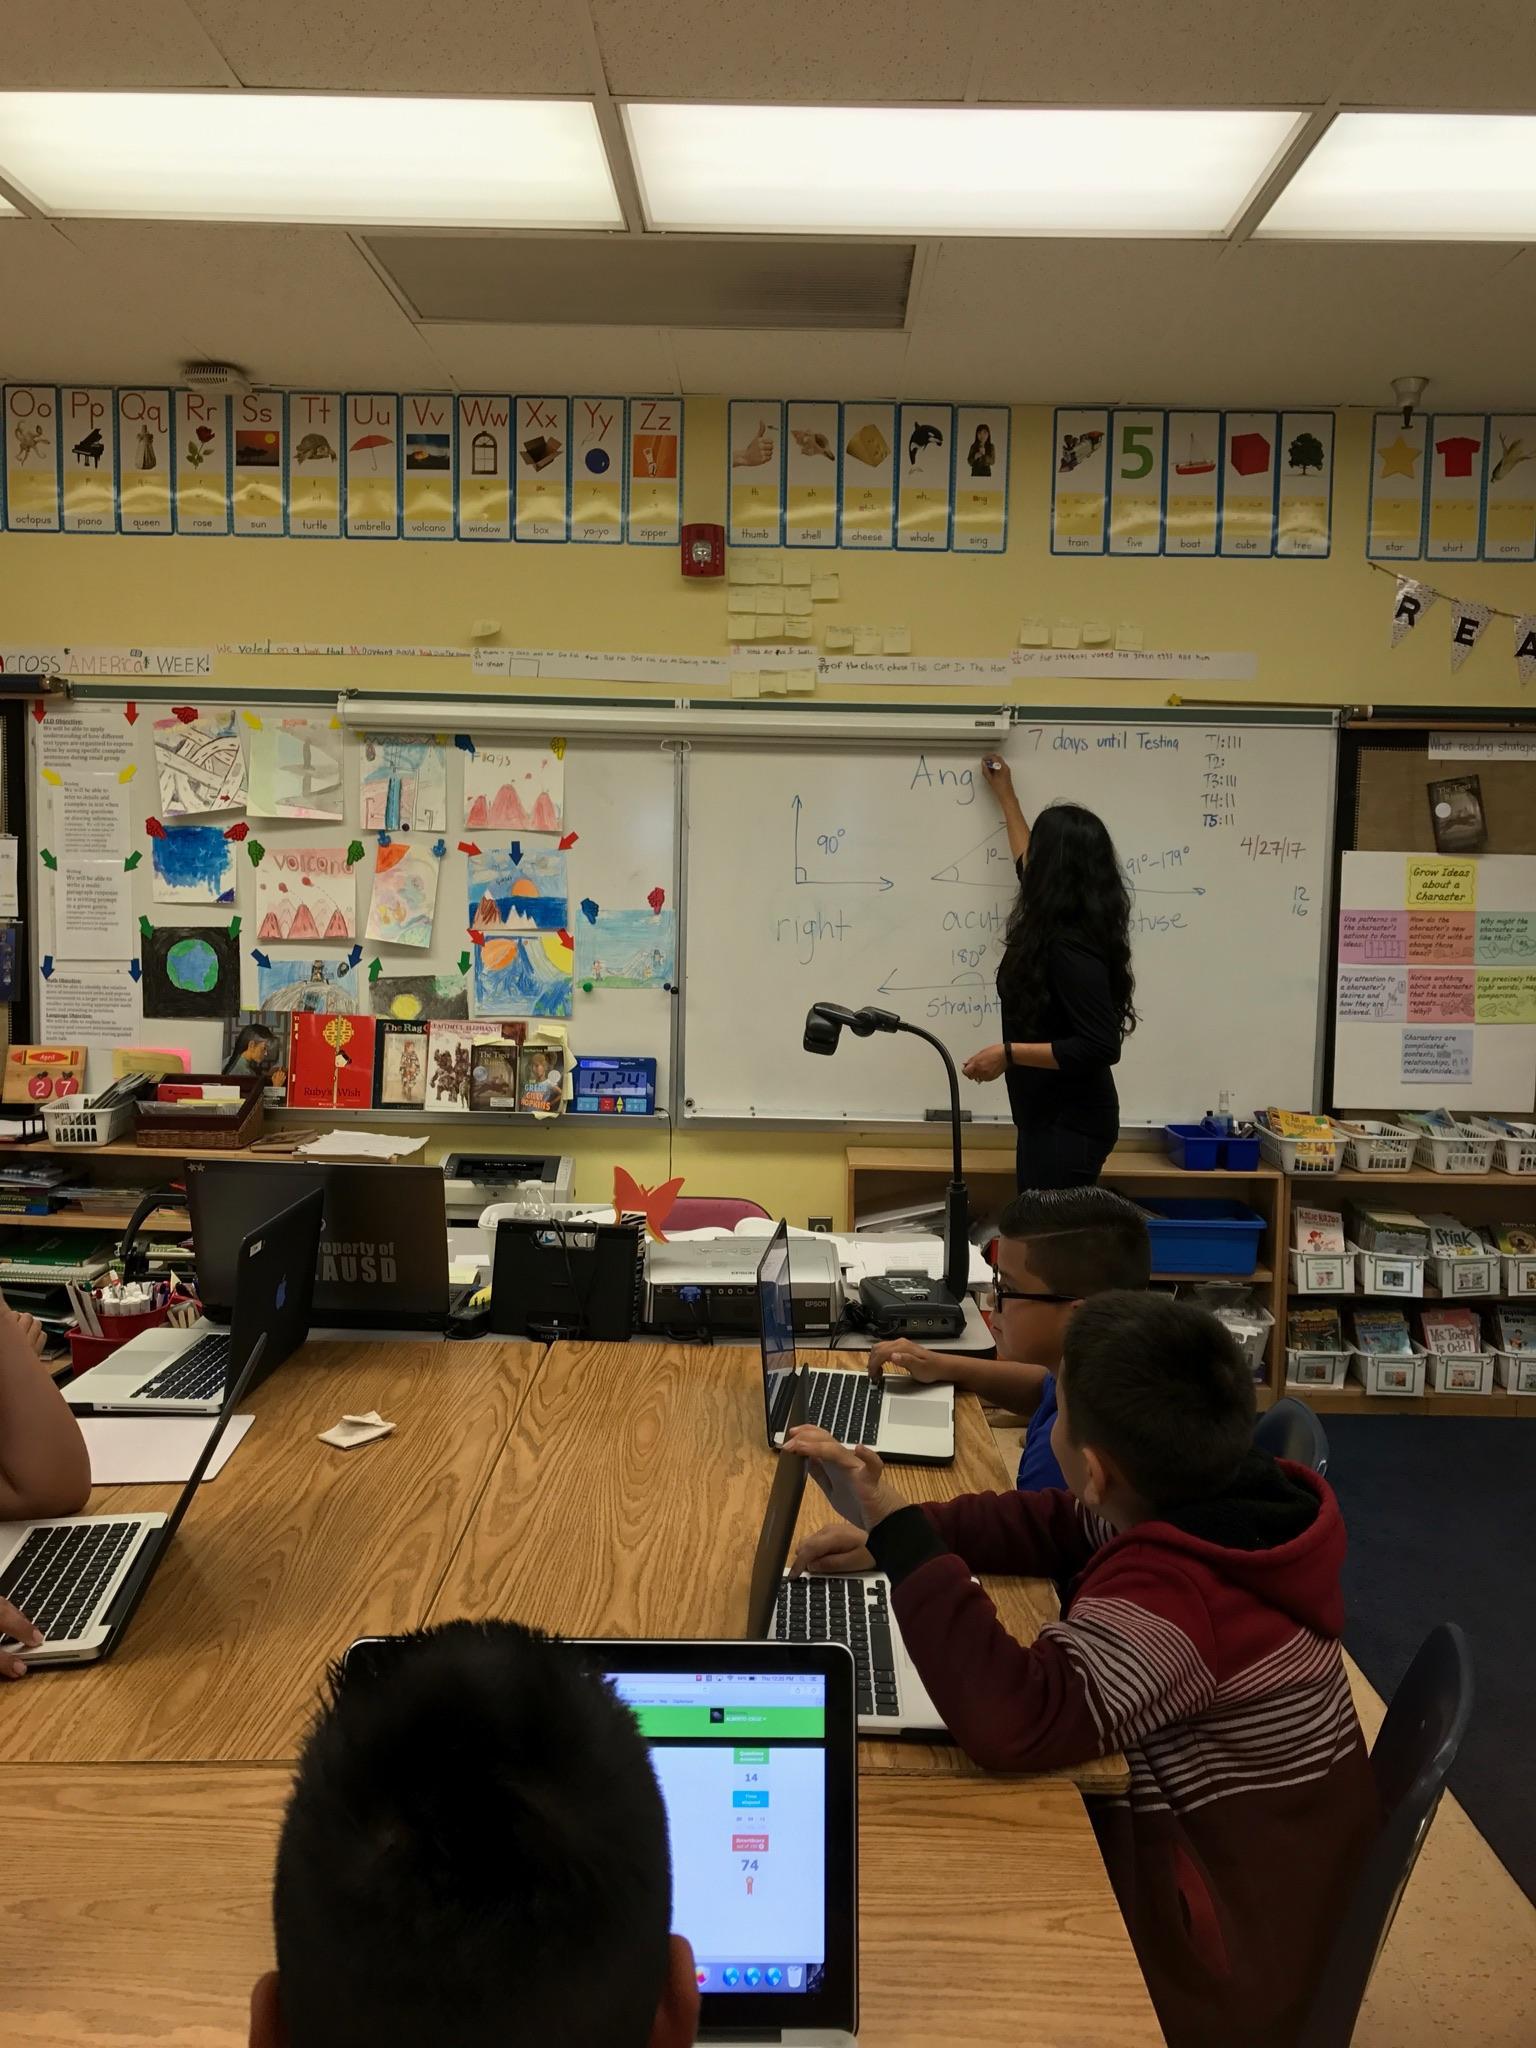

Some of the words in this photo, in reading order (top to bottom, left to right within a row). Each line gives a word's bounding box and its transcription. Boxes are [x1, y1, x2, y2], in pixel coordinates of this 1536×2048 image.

[10, 390, 52, 418] Oo
[187, 393, 217, 422] Rr
[242, 395, 272, 424] Ss
[72, 391, 105, 429] Pp
[121, 393, 167, 433] Qq
[300, 397, 331, 424] Tt
[353, 398, 390, 426] Uu
[413, 399, 444, 426] Vv
[461, 399, 508, 428] Ww
[526, 401, 558, 429] Xx
[584, 401, 613, 442] Yy
[640, 403, 671, 431] Zz
[1120, 426, 1154, 479] 5
[15, 515, 52, 527] octopus
[77, 516, 103, 527] piano
[133, 518, 160, 530] queen
[192, 519, 213, 528] rose
[250, 520, 267, 529] sun
[302, 521, 328, 531] turtle
[353, 521, 391, 532] umbrella
[412, 522, 446, 533] volcano
[469, 523, 501, 534] window
[533, 525, 549, 536] box
[583, 527, 610, 538] yo-yo
[640, 528, 668, 539] zipper
[741, 529, 769, 540] thumb
[801, 530, 822, 540] shell
[851, 531, 883, 542] cheese
[910, 532, 935, 543] whale
[970, 535, 988, 549] sing
[1068, 538, 1089, 548] train
[1126, 537, 1143, 548] five
[1180, 539, 1201, 549] boat
[1235, 540, 1257, 550] cube
[1293, 540, 1312, 550] tree
[1385, 543, 1404, 552] star
[1442, 543, 1463, 553] shirt
[1499, 544, 1520, 553] corn
[156, 654, 211, 673] WEEK!
[1027, 728, 1043, 752] 7
[1052, 728, 1089, 755] days
[1096, 731, 1127, 750] until
[1135, 732, 1179, 751] Testing
[1430, 737, 1453, 752] What
[1458, 736, 1494, 758] reading
[910, 754, 975, 805] Ang
[1240, 835, 1306, 863] 4/27/17
[1413, 867, 1440, 877] Grow
[1441, 867, 1471, 878] Ideas
[1422, 879, 1452, 889] about
[1294, 886, 1309, 901] 12
[1415, 891, 1466, 901] Character
[942, 902, 1002, 932] acut
[1358, 915, 1388, 924] patterns
[776, 909, 852, 965] right
[1355, 1000, 1370, 1008] they
[384, 1022, 402, 1032] The
[403, 1023, 422, 1034] Rag
[39, 1054, 56, 1062] April
[35, 1081, 45, 1096] 2
[61, 1081, 70, 1096] 7
[337, 1087, 361, 1097] Wish
[1435, 1228, 1476, 1248] Stink
[379, 1241, 395, 1256] of
[804, 1300, 828, 1309] EPSON
[745, 1773, 758, 1782] 14
[740, 1859, 759, 1872] 74
